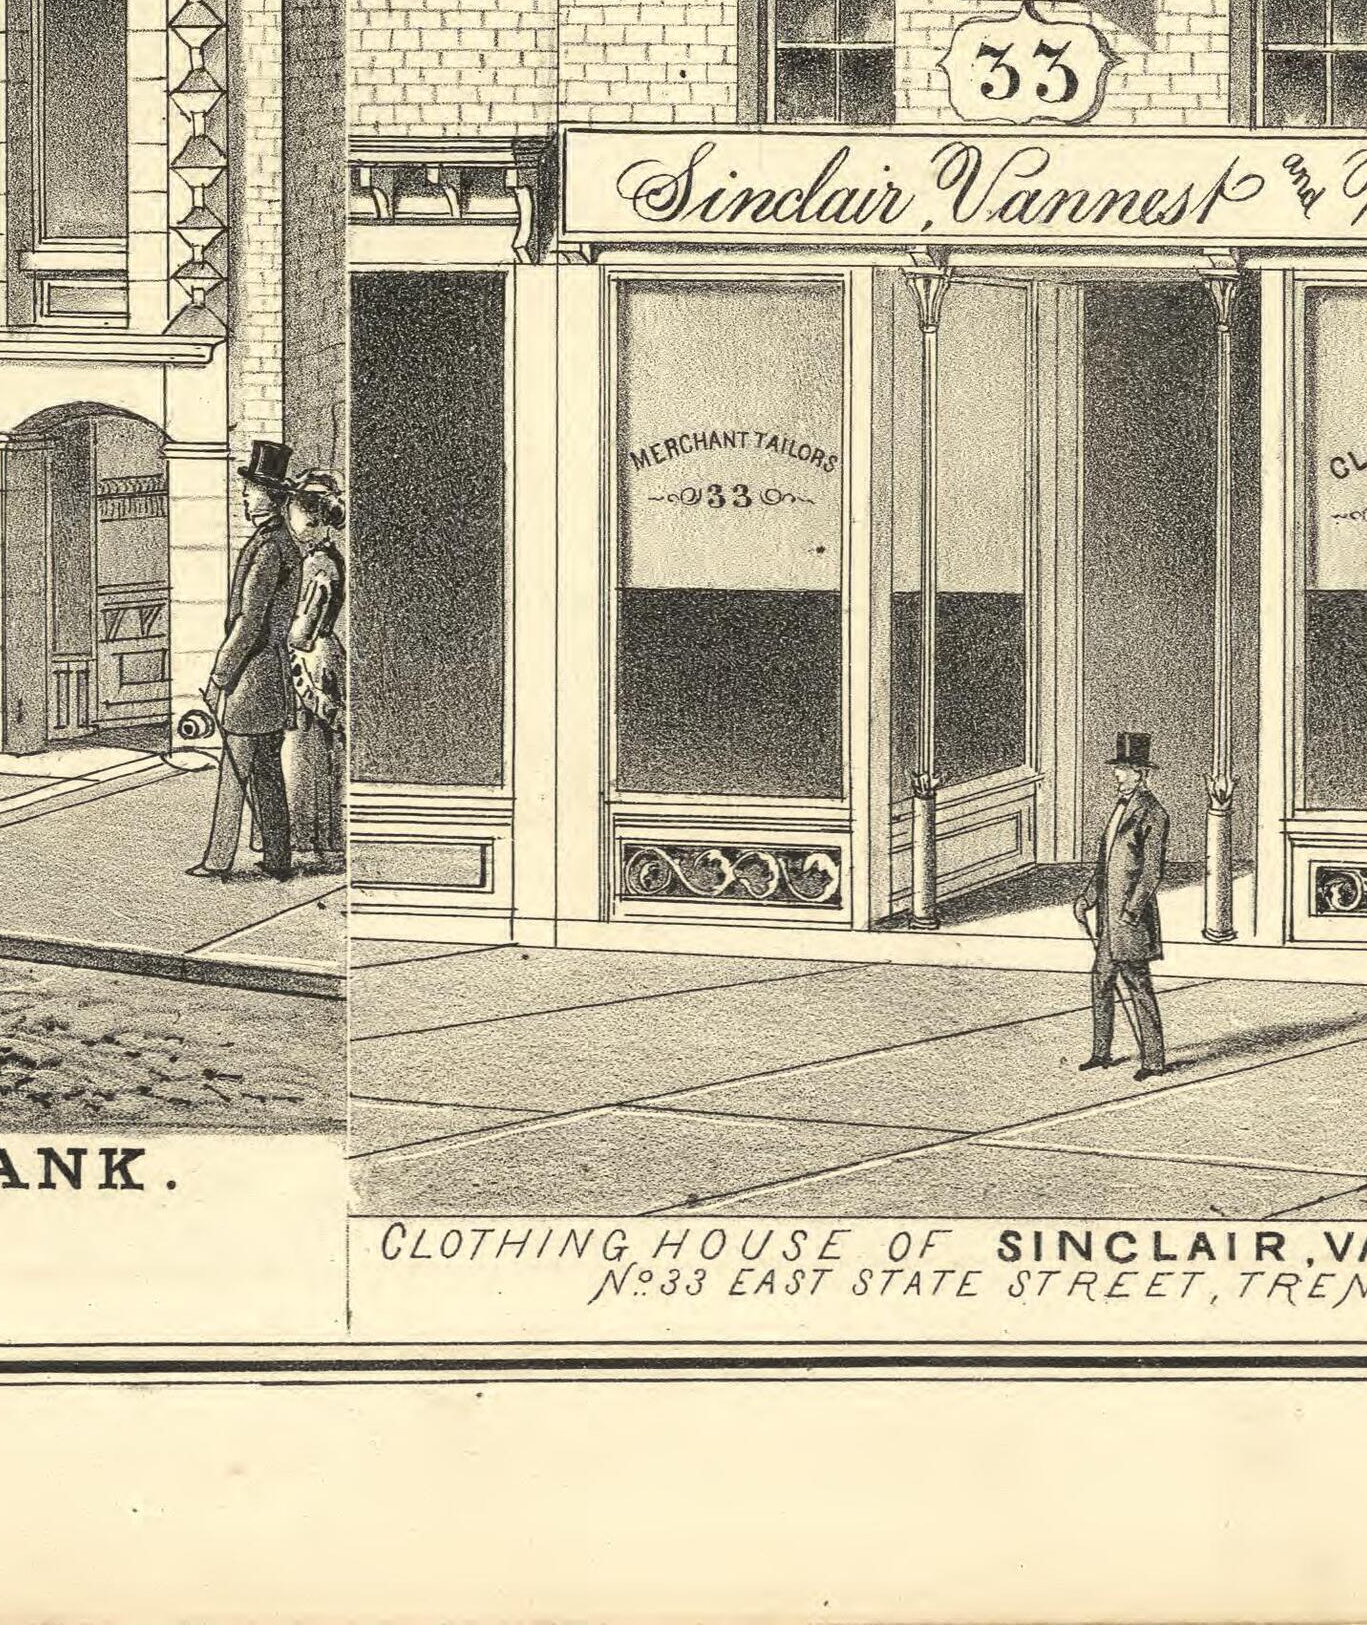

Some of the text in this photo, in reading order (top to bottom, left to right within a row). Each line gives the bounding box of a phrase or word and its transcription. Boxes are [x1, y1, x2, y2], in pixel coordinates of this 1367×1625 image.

[976, 39, 1079, 104] 33
[931, 141, 1266, 225] Vannest
[1282, 152, 1327, 221] and
[630, 431, 839, 473] MERCHANT TAILORS
[707, 483, 753, 509] 33
[382, 1221, 629, 1262] CLOTHING
[652, 1228, 852, 1262] HOUSE
[888, 1229, 953, 1263] OF
[728, 1268, 833, 1296] EAST
[852, 1268, 982, 1297] STATE
[1008, 1270, 1218, 1305] STREET,
